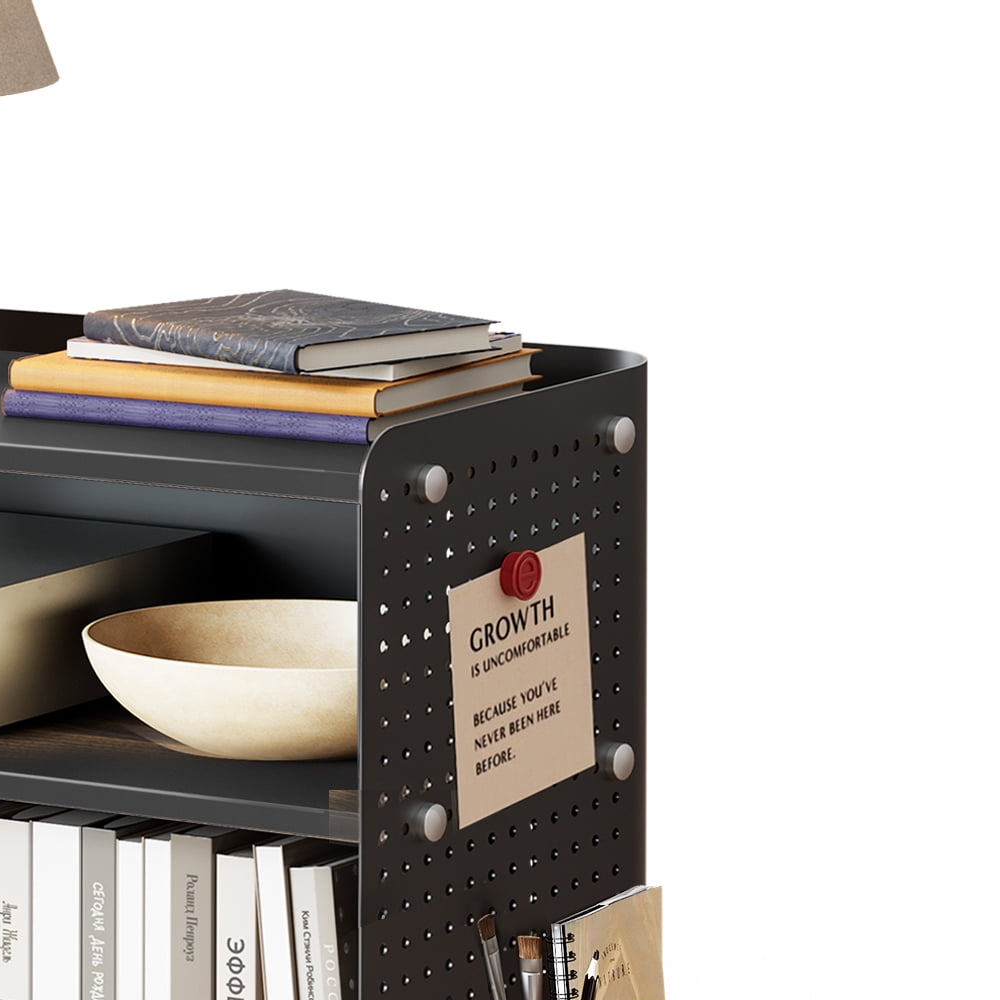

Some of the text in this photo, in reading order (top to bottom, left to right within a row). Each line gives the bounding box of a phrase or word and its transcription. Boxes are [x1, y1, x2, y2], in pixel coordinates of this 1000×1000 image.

[470, 595, 555, 652] GROWTH
[471, 622, 570, 678] IS UNCOMFORTABLE
[473, 696, 518, 728] BECAUSE
[474, 700, 561, 751] NEVER BEEN HERE
[476, 746, 516, 776] BEFORE.
[90, 882, 105, 931] СЕГОДНЯ
[183, 873, 199, 962] Роланд Пенроуз
[302, 910, 312, 929] Ким
[88, 935, 106, 967] ДЕНЬ
